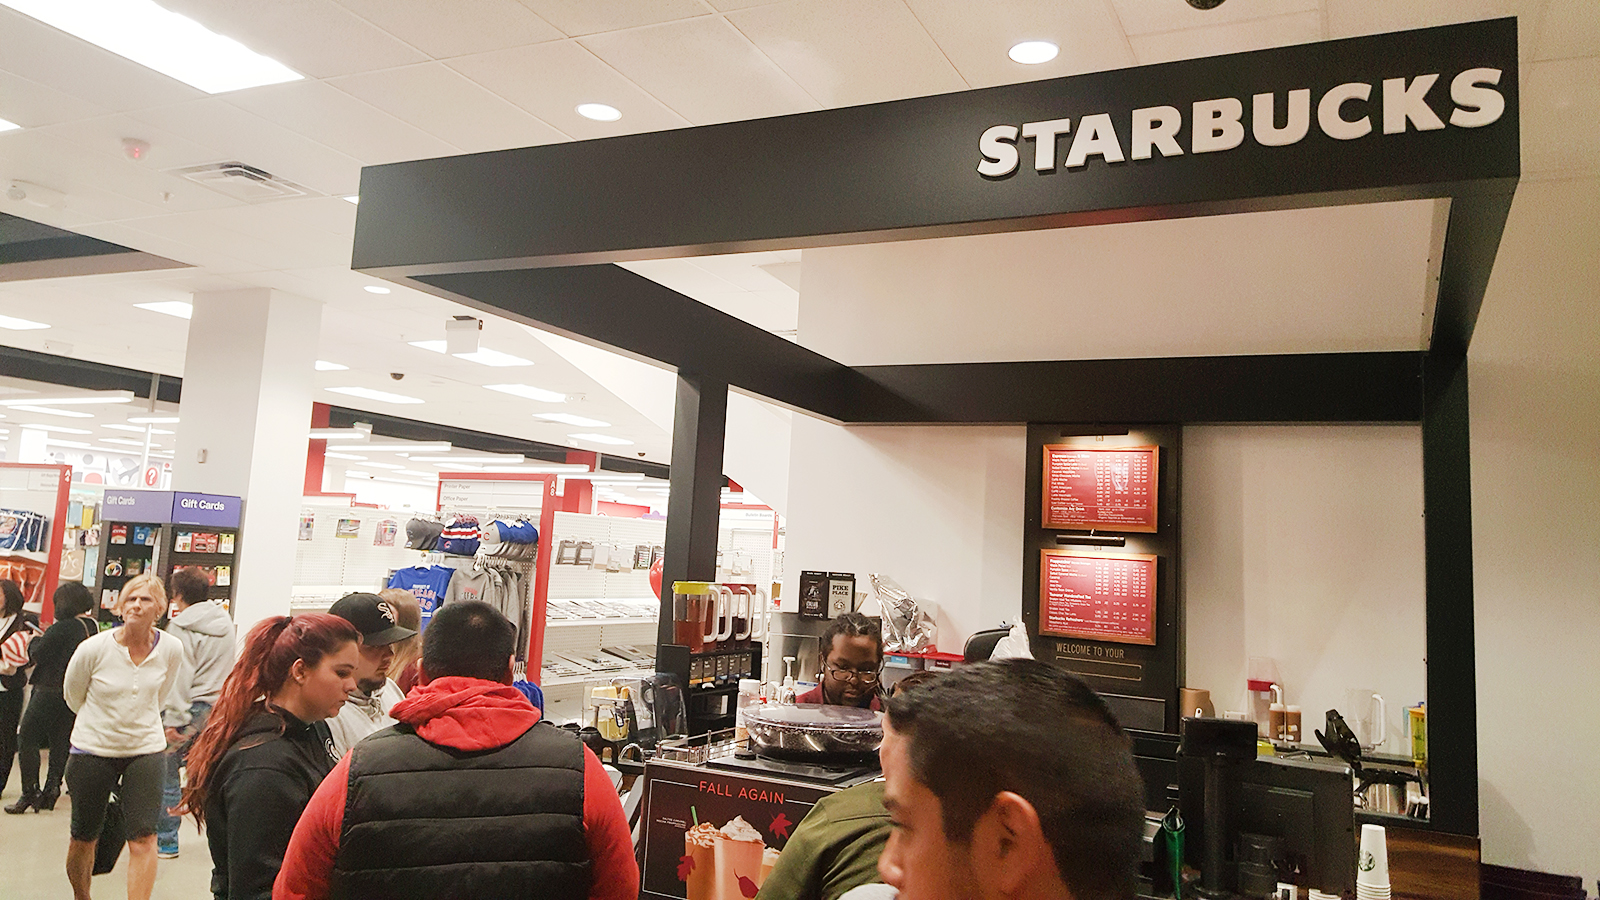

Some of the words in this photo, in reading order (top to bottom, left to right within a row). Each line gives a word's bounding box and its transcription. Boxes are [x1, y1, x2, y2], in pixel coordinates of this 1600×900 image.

[976, 67, 1506, 178] STARBUCKS
[106, 495, 118, 505] Gift
[118, 496, 136, 506] Cards
[181, 497, 198, 509] Gift
[198, 499, 226, 511] Cards
[1056, 642, 1091, 656] WELCOME
[1092, 646, 1103, 657] TO
[1104, 647, 1125, 659] YOUR
[699, 780, 733, 797] FALL
[737, 787, 784, 805] AGAIN
